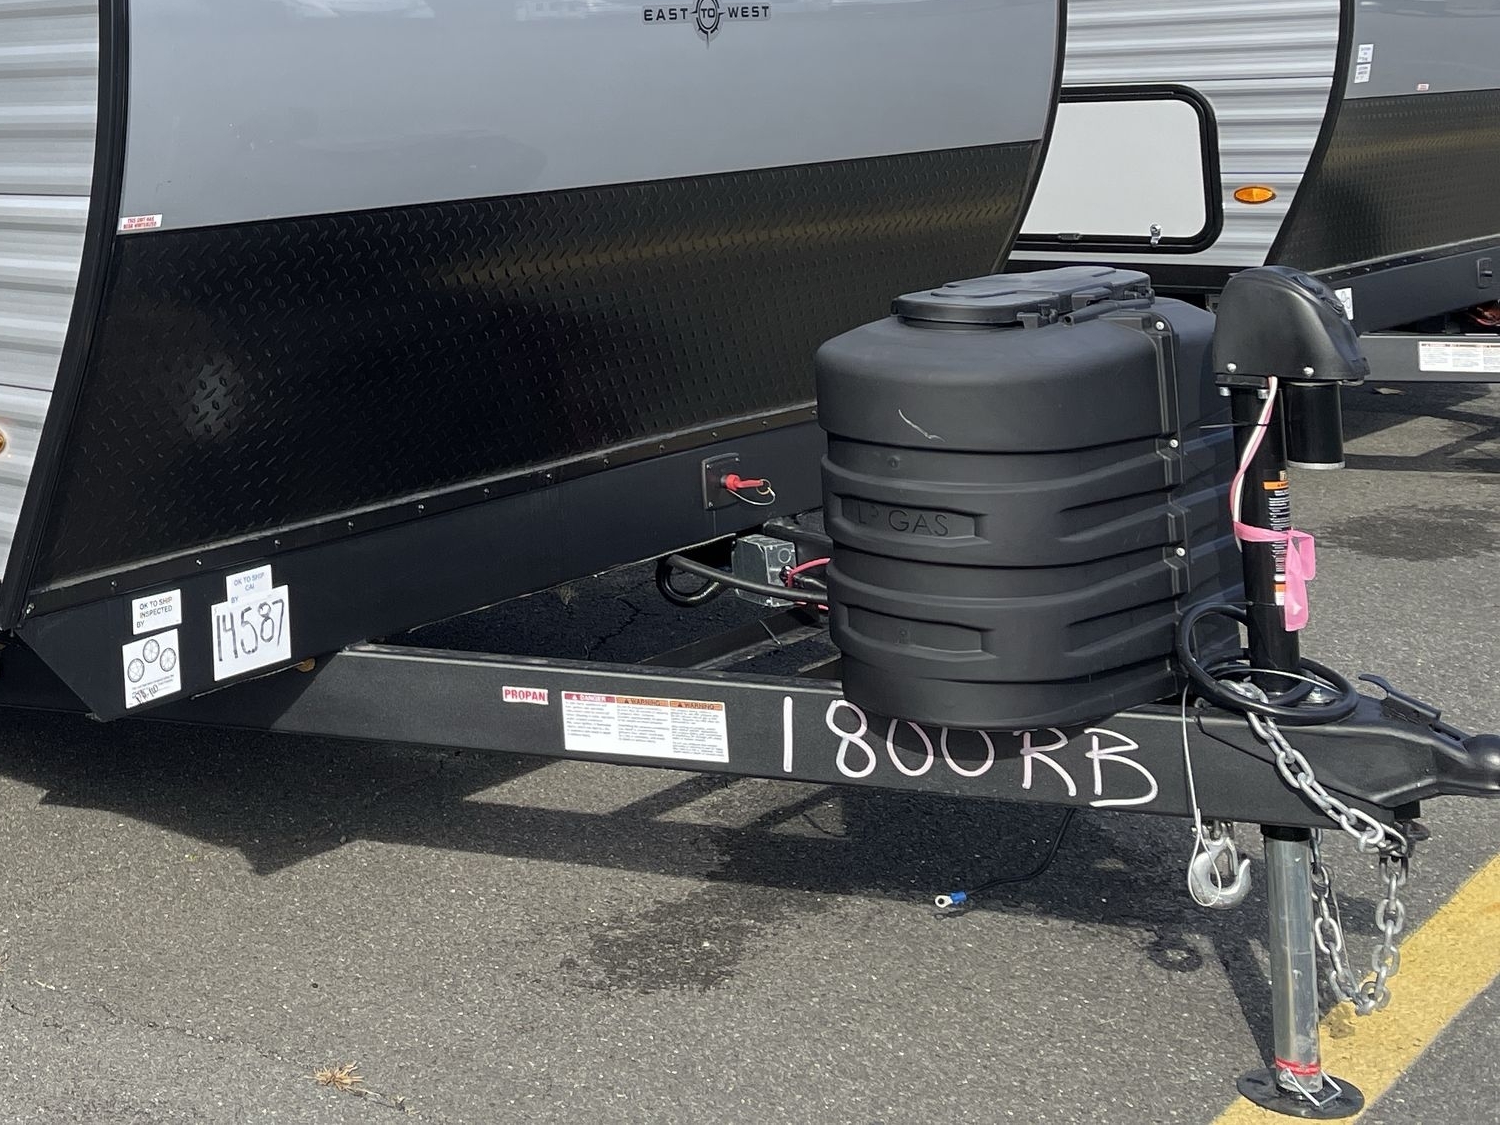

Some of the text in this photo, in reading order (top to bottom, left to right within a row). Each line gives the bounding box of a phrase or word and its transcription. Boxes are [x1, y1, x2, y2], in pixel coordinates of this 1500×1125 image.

[643, 6, 769, 21] EAST TO WEST
[888, 509, 949, 537] GAS
[139, 596, 173, 610] OK TO SHIP
[139, 605, 173, 619] INSPECTED
[136, 620, 145, 628] BY
[216, 598, 284, 662] 14587
[504, 689, 548, 702] PROPAN
